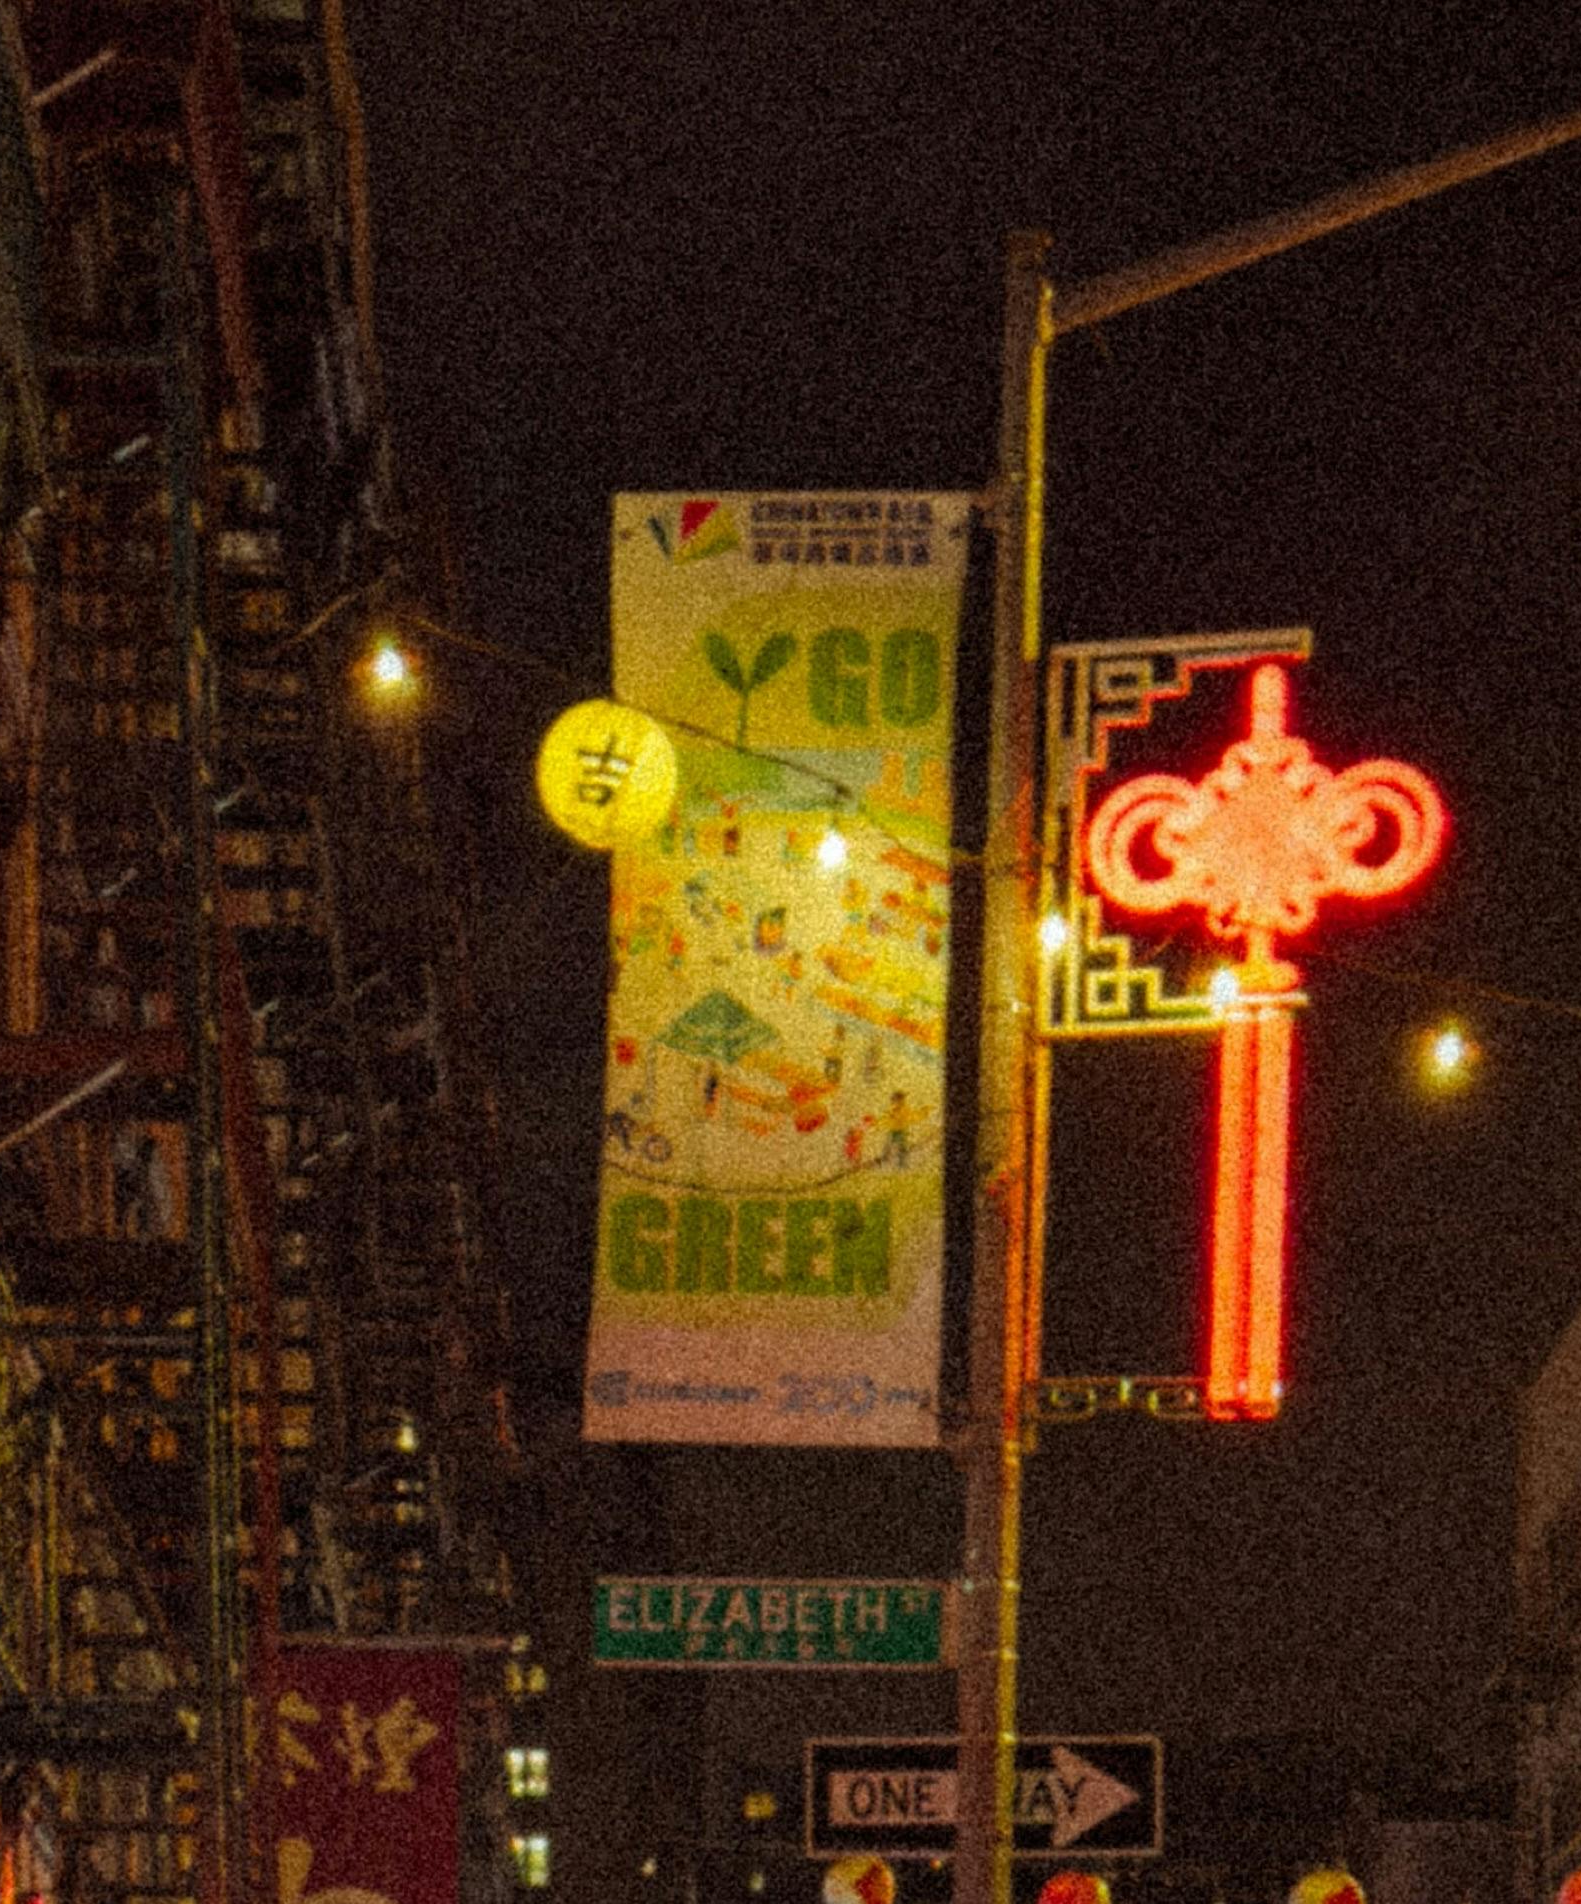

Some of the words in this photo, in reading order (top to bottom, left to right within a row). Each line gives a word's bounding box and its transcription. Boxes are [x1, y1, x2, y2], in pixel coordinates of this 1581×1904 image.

[807, 627, 942, 729] GO
[608, 1195, 891, 1297] GREEN
[608, 1588, 889, 1634] ELIZABETH
[845, 1775, 940, 1820] ONE
